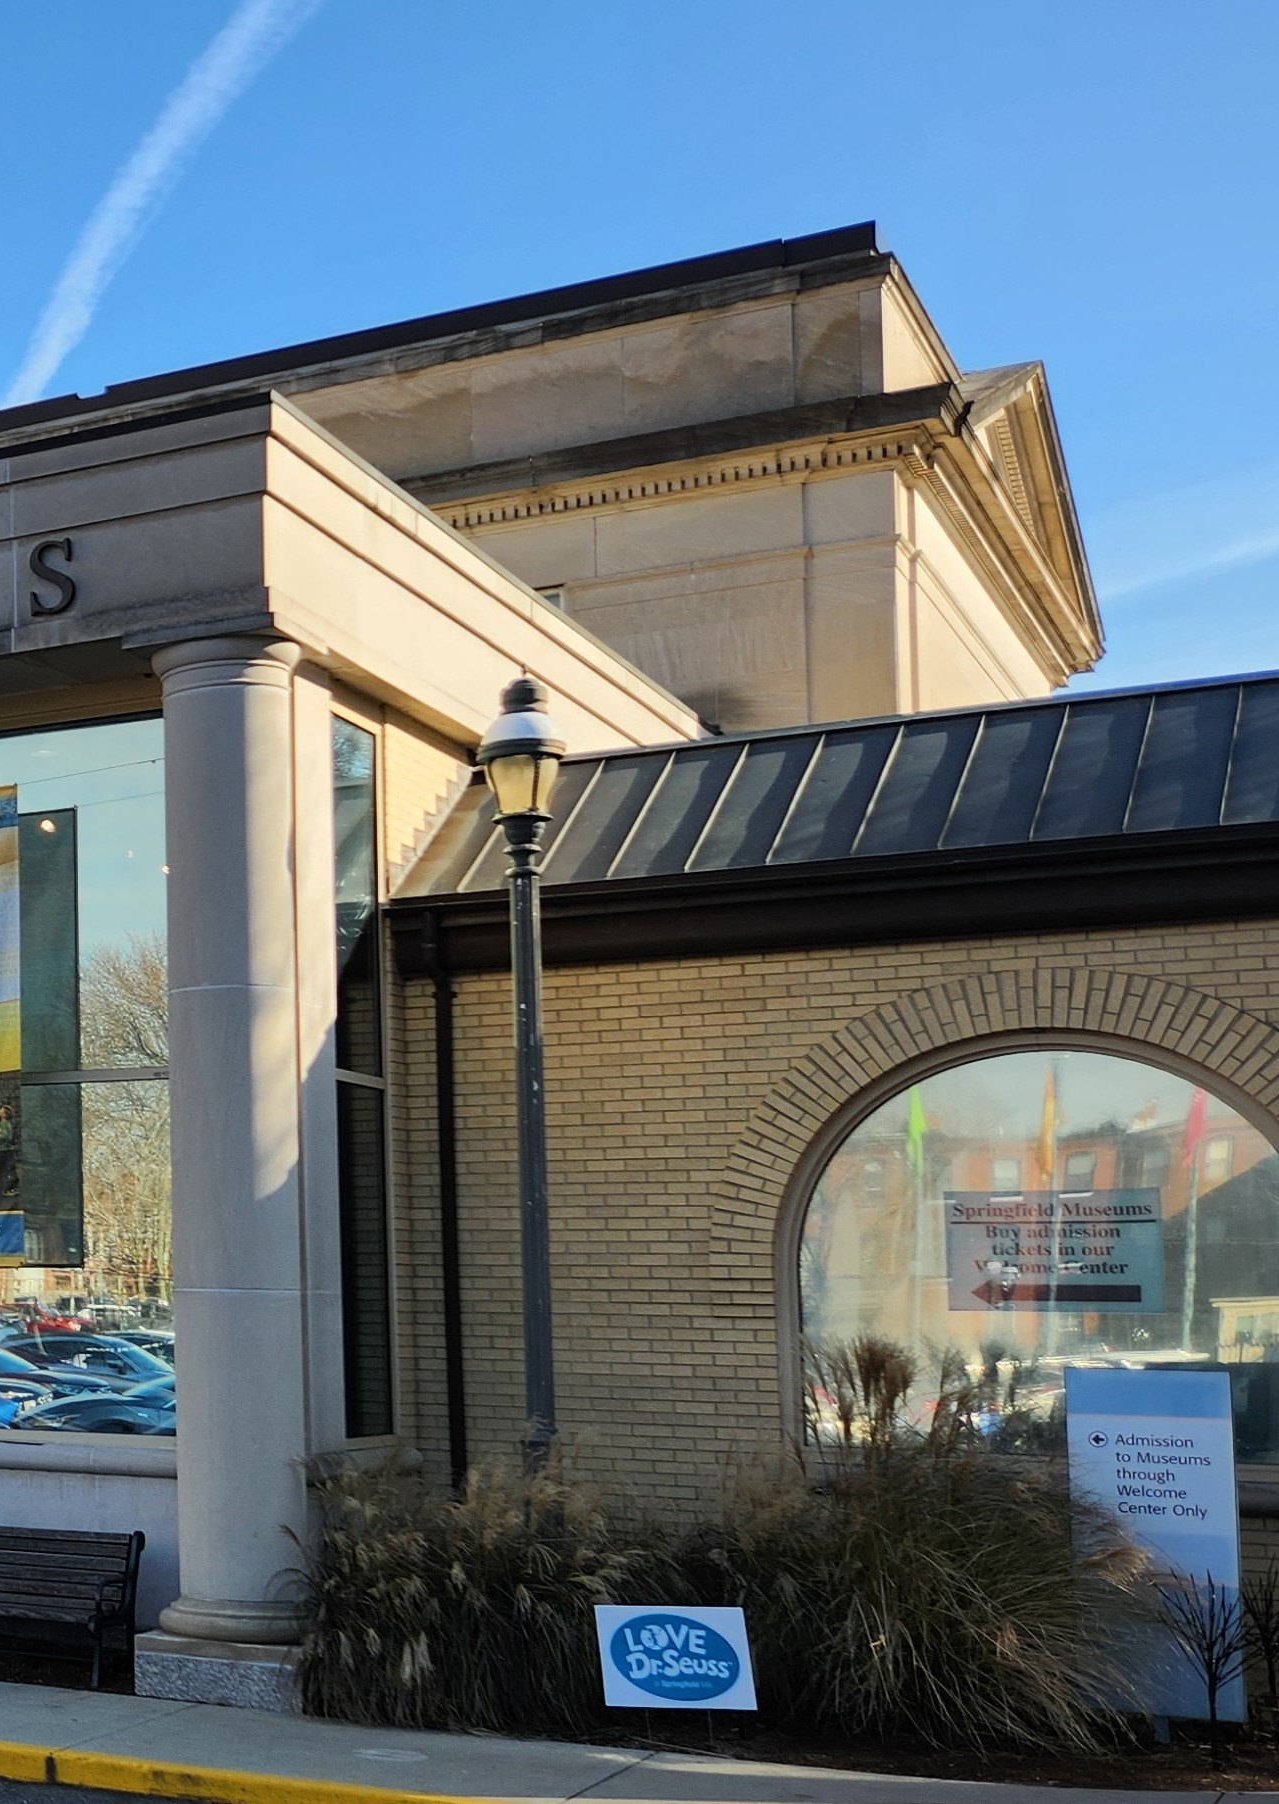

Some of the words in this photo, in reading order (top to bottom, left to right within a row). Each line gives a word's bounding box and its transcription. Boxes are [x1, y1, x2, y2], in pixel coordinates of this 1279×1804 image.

[952, 1203, 1054, 1220] Springfield
[1062, 1203, 1152, 1217] Museums
[985, 1225, 1020, 1241] Buy
[992, 1243, 1051, 1256] tickets
[1058, 1242, 1075, 1256] in
[1082, 1245, 1114, 1256] our
[1115, 1433, 1194, 1448] Admission
[1116, 1452, 1131, 1463] to
[1137, 1452, 1211, 1466] Museums
[1116, 1467, 1176, 1485] through
[1116, 1484, 1187, 1499] Welcome
[1118, 1501, 1167, 1515] Center
[1173, 1504, 1208, 1520] Only
[623, 1623, 707, 1655] LOVE
